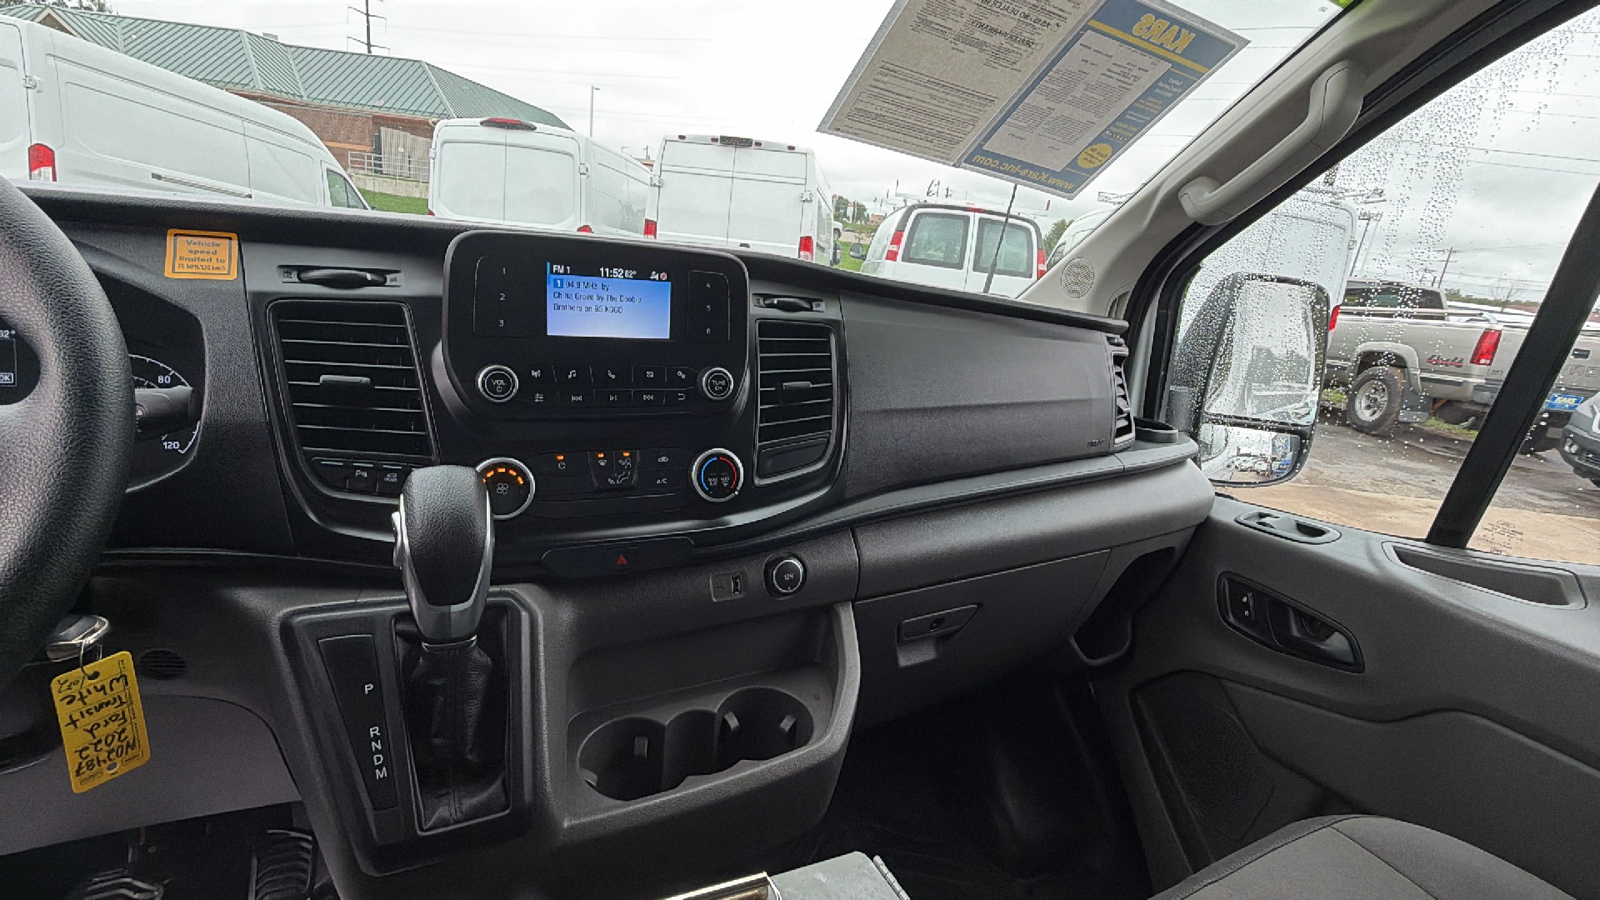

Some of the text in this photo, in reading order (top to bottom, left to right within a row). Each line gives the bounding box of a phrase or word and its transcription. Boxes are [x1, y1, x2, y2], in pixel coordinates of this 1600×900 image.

[179, 255, 212, 263] limited
[552, 264, 565, 274] FM
[566, 266, 571, 274] 1
[600, 267, 624, 279] 11:52
[582, 281, 598, 290] MHz
[601, 281, 610, 292] by
[499, 293, 506, 301] 2
[575, 292, 594, 301] Grove
[596, 294, 604, 303] by
[606, 294, 618, 302] The
[553, 303, 583, 312] Brothers
[584, 305, 593, 313] on
[498, 319, 504, 327] 3
[157, 375, 171, 384] 80
[162, 441, 180, 450] 120
[783, 573, 794, 581] 12V
[60, 674, 129, 706] White
[364, 683, 374, 695] P
[65, 694, 127, 729] Transit
[83, 710, 128, 740] Ford
[369, 726, 380, 738] R
[74, 727, 128, 760] 2022
[371, 739, 382, 752] N
[373, 754, 384, 766] D
[375, 766, 388, 780] M
